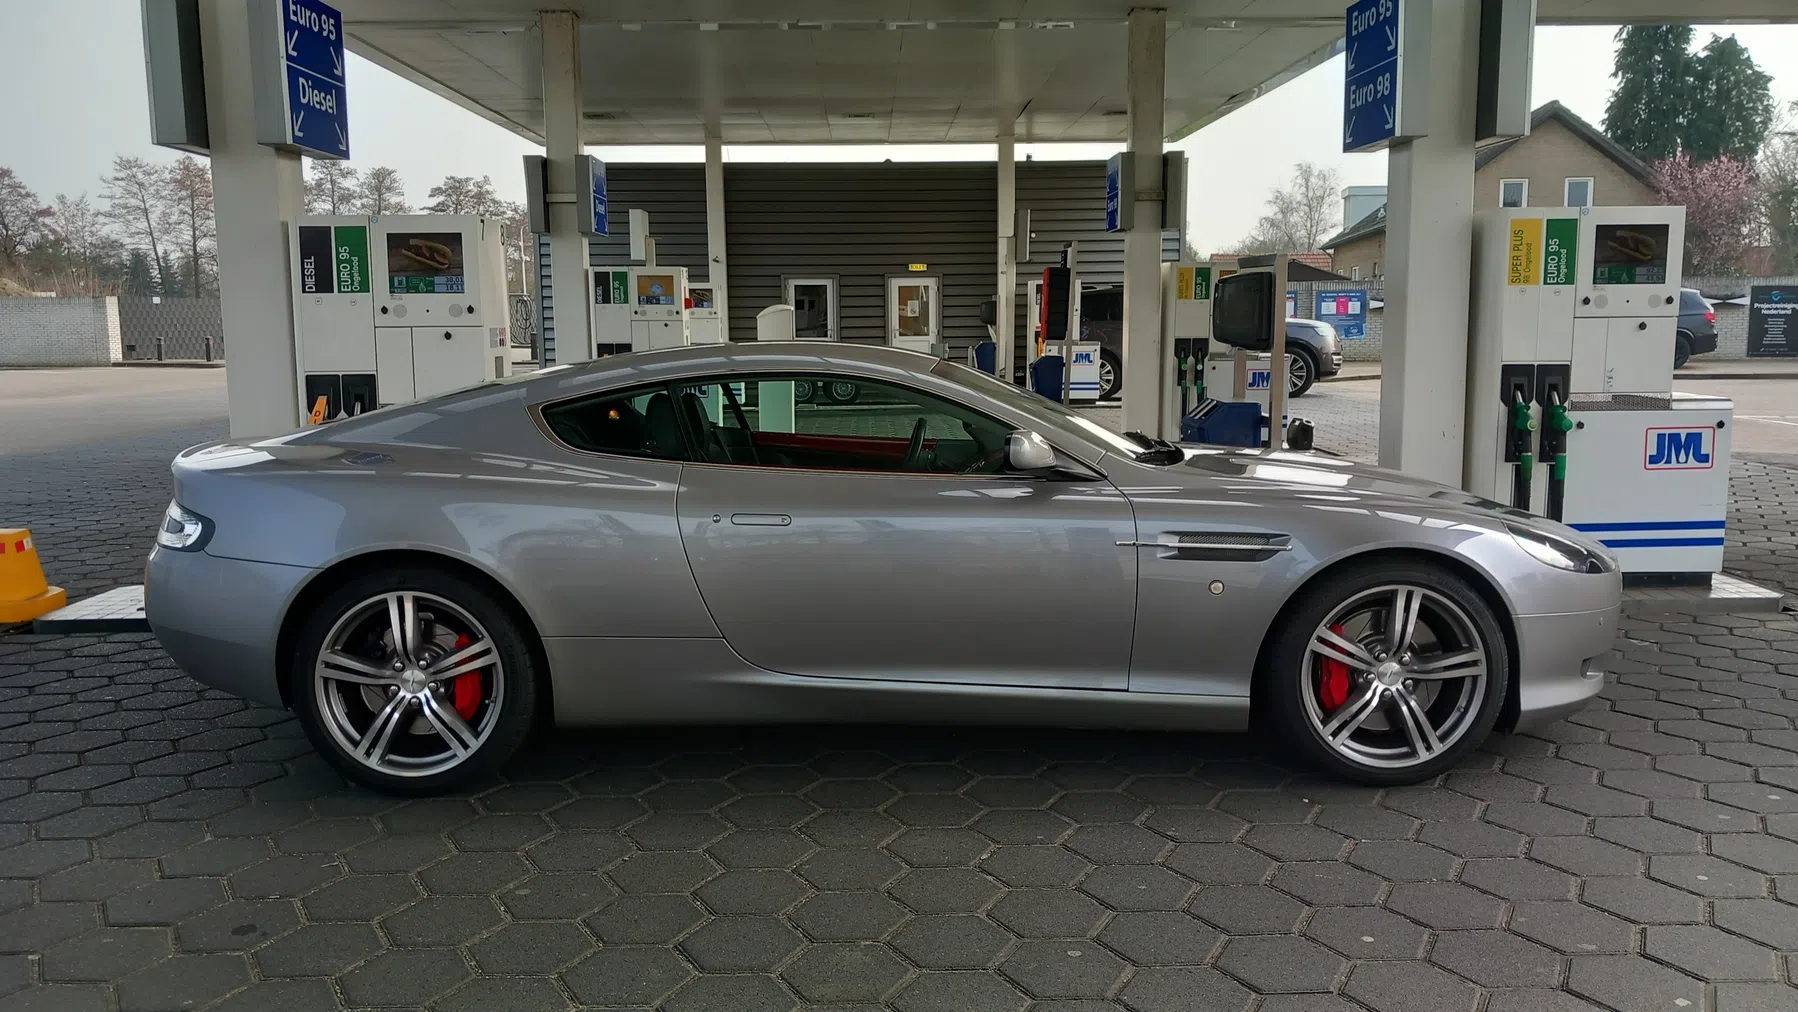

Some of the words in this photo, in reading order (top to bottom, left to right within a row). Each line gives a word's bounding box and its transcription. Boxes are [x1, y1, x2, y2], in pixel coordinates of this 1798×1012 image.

[289, 0, 319, 32] Euro
[321, 14, 336, 41] 95
[1351, 7, 1377, 37] Euro
[1379, 0, 1393, 21] 95
[299, 77, 337, 115] Diesel
[1350, 82, 1374, 110] Euro
[1377, 72, 1391, 99] 98
[480, 218, 485, 241] 7
[500, 224, 505, 246] 8
[1513, 229, 1524, 252] PLUS
[338, 246, 349, 259] 95
[1548, 238, 1559, 252] 95
[304, 255, 316, 292] DIESEL
[339, 263, 351, 292] EURO
[351, 256, 361, 292] Ongelood
[1511, 254, 1523, 284] SUPER
[1546, 255, 1559, 283] EURO
[1558, 248, 1567, 283] Ongelood
[1073, 352, 1093, 364] JML
[1248, 371, 1271, 388] JM
[1648, 432, 1709, 465] JML
